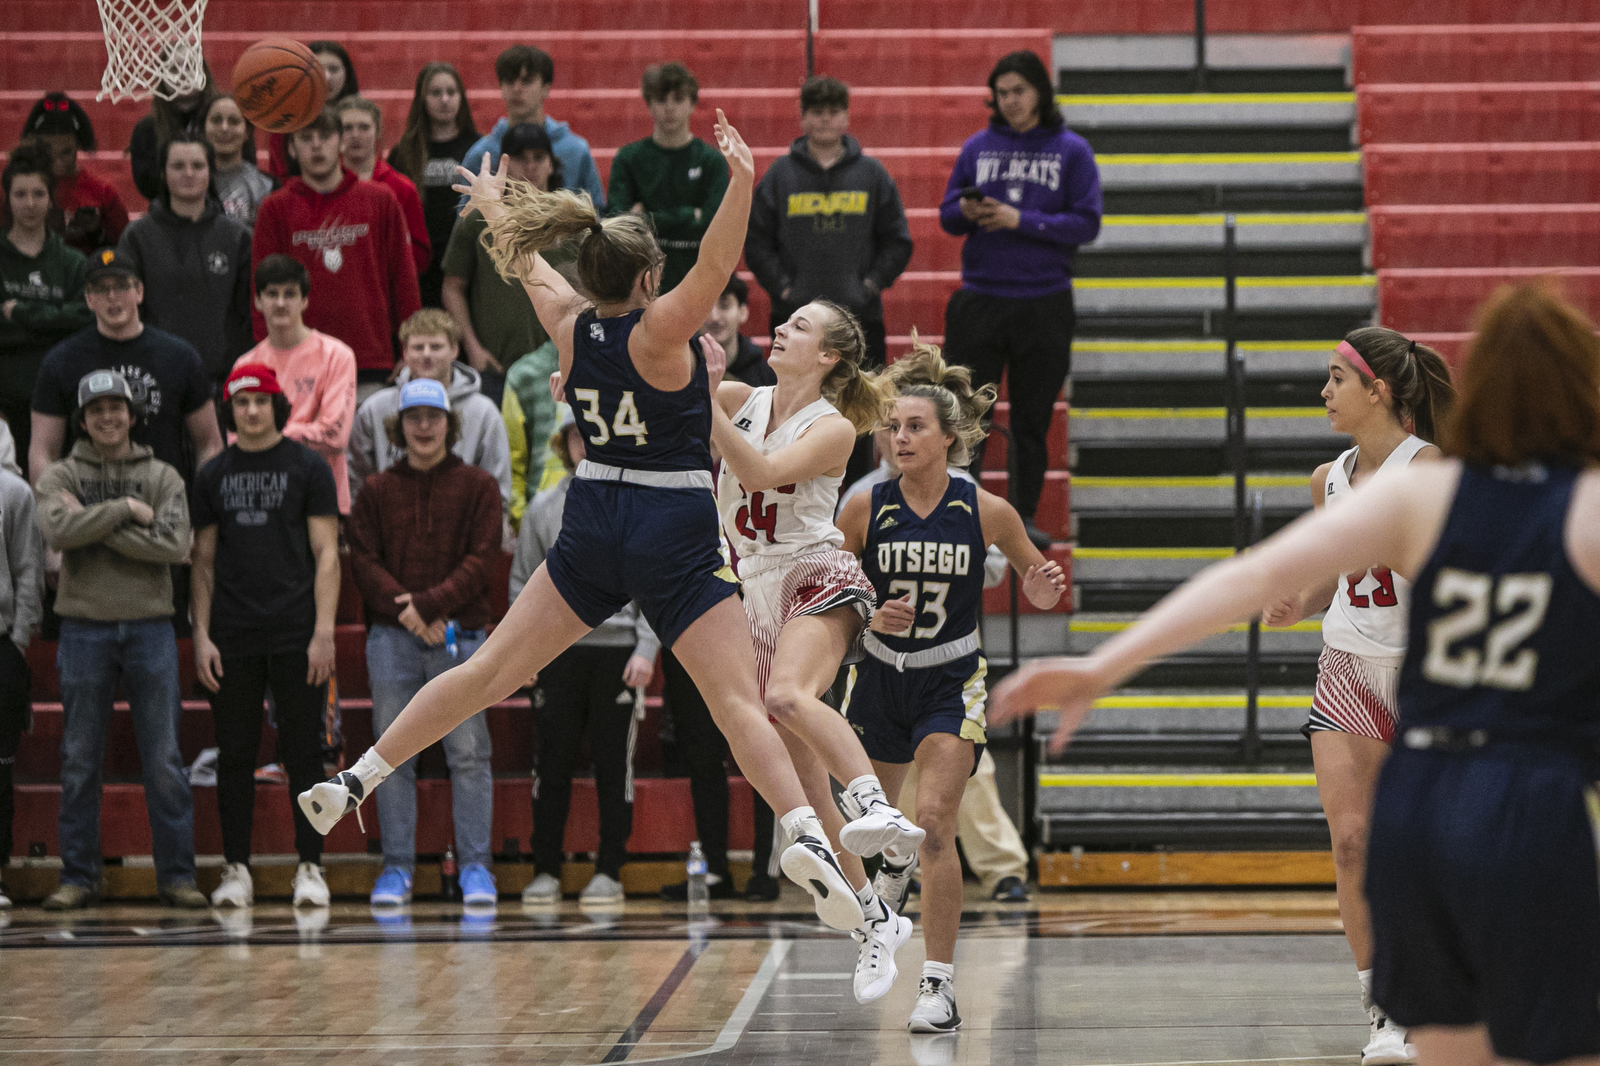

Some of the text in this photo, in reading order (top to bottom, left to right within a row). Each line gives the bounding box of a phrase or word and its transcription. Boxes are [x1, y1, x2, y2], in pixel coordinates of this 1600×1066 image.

[574, 387, 648, 446] 34
[220, 471, 288, 495] AMERICAN
[735, 491, 778, 543] 24
[877, 541, 971, 576] OTSEGO
[888, 579, 951, 639] 23
[1423, 566, 1553, 691] 22
